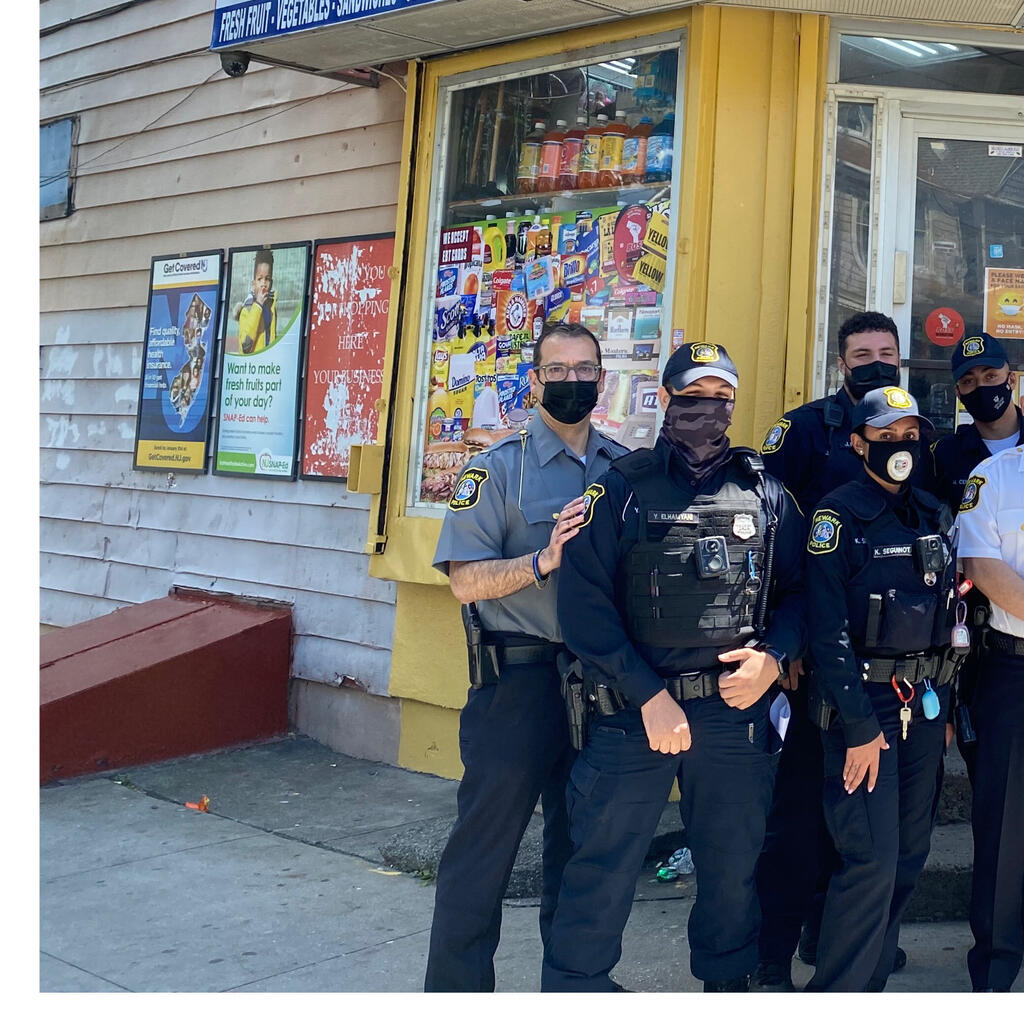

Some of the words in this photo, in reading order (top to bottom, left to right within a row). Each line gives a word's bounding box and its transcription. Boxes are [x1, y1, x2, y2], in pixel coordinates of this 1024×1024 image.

[219, 7, 246, 43] FRESH
[245, 1, 272, 36] FRUIT
[443, 231, 450, 245] WE
[450, 229, 469, 244] ACCEPT
[442, 249, 451, 263] EBT
[175, 260, 201, 273] Covered
[362, 264, 386, 280] YOU
[639, 261, 664, 283] YELLOW
[493, 276, 512, 285] Colgate
[149, 327, 162, 336] Find
[338, 335, 364, 350] HERE
[227, 362, 248, 375] Want
[248, 362, 257, 374] to
[257, 362, 281, 375] make
[225, 378, 245, 391] fresh
[245, 378, 264, 391] fruits
[265, 380, 282, 393] part
[452, 375, 471, 387] Domino
[224, 394, 234, 407] of
[234, 397, 252, 410] your
[253, 394, 273, 410] day?
[809, 540, 831, 549] POLICE
